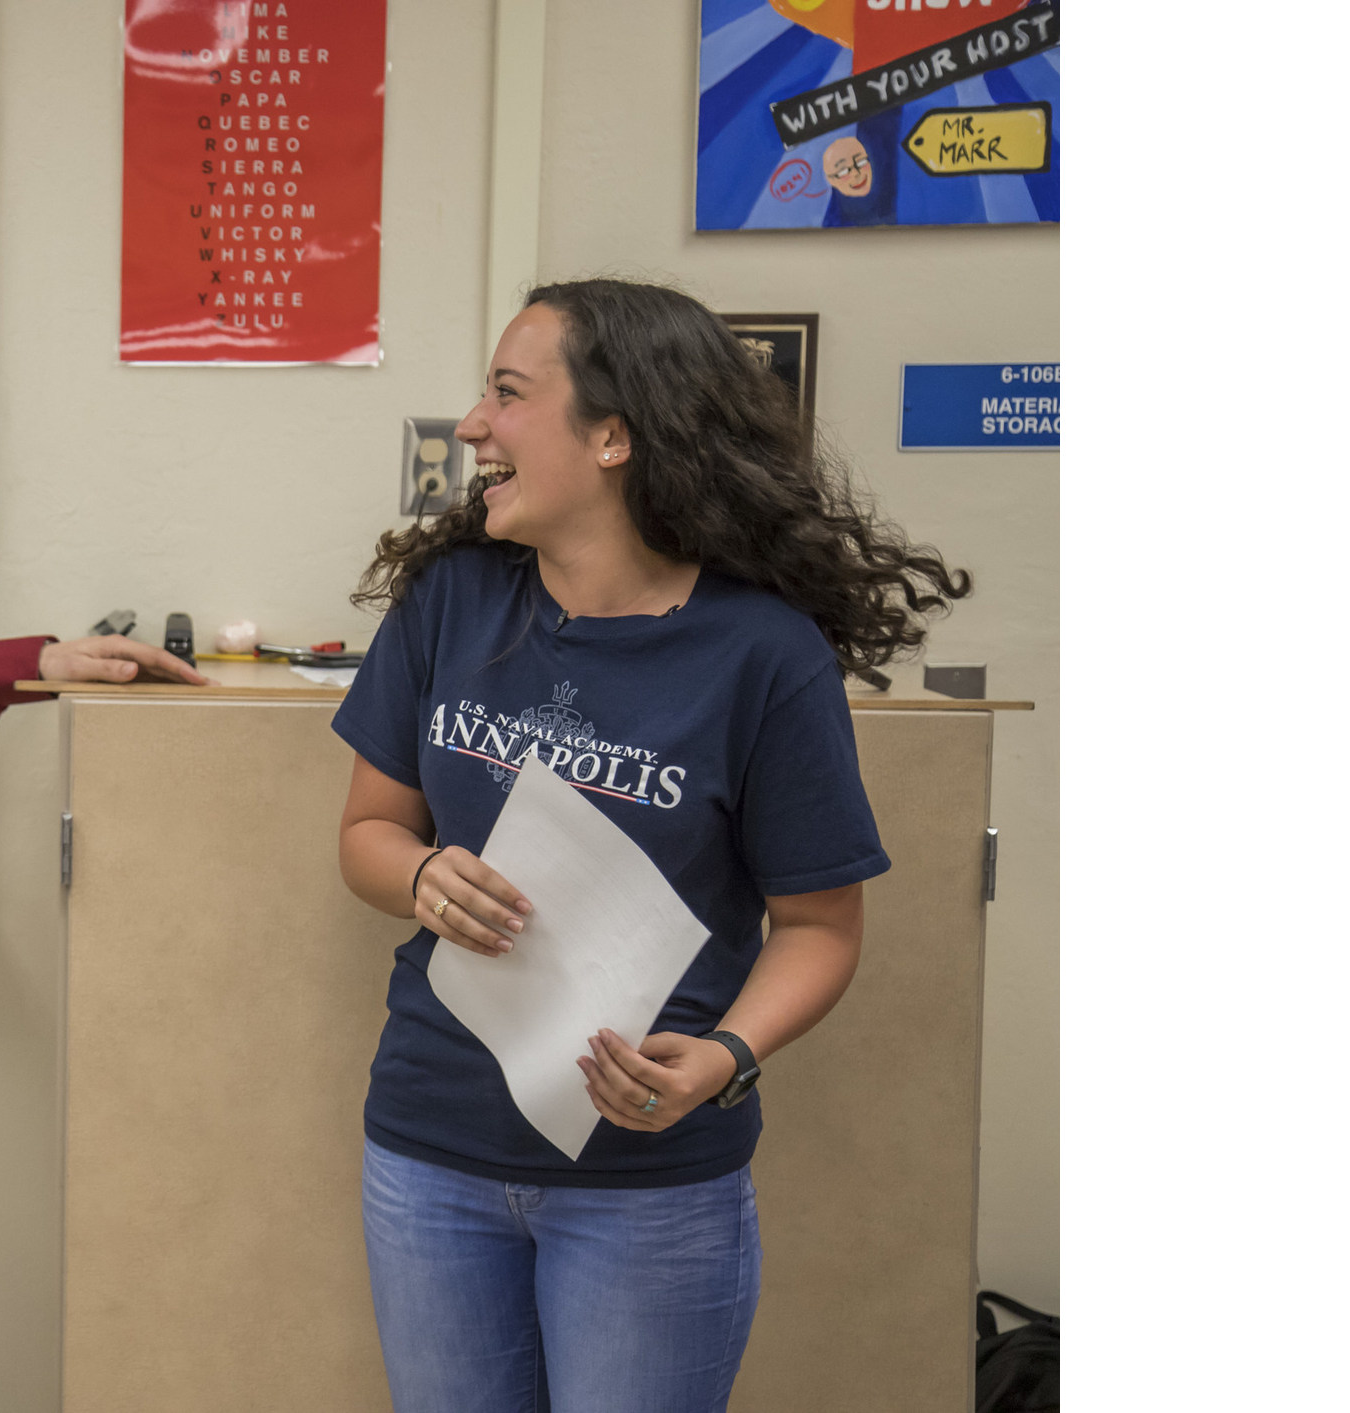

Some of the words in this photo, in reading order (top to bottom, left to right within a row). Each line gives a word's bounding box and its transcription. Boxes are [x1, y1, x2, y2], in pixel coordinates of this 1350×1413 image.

[223, 3, 288, 17] LIMA
[222, 25, 289, 40] MIKE
[180, 48, 329, 63] NOVEMBER
[209, 70, 301, 85] OSCAR
[782, 84, 858, 133] WITH
[866, 48, 957, 101] YOUR
[966, 11, 1054, 64] HOST
[220, 93, 287, 108] PAPA
[198, 115, 310, 130] QUEBEC
[942, 115, 985, 137] MR.
[205, 137, 300, 152] ROMEO
[939, 136, 1008, 165] MARR
[201, 160, 303, 175] SIERRA
[207, 182, 298, 197] TANGO
[190, 204, 316, 219] UNIFORM
[200, 226, 303, 241] VICTOR
[199, 248, 305, 263] WHISKY
[211, 270, 292, 285] X-RAY
[198, 292, 304, 307] YANKEE
[215, 314, 284, 328] ZULU
[981, 397, 1060, 414] MATERI
[458, 700, 488, 719] U.S.
[495, 713, 555, 742] NAVAL
